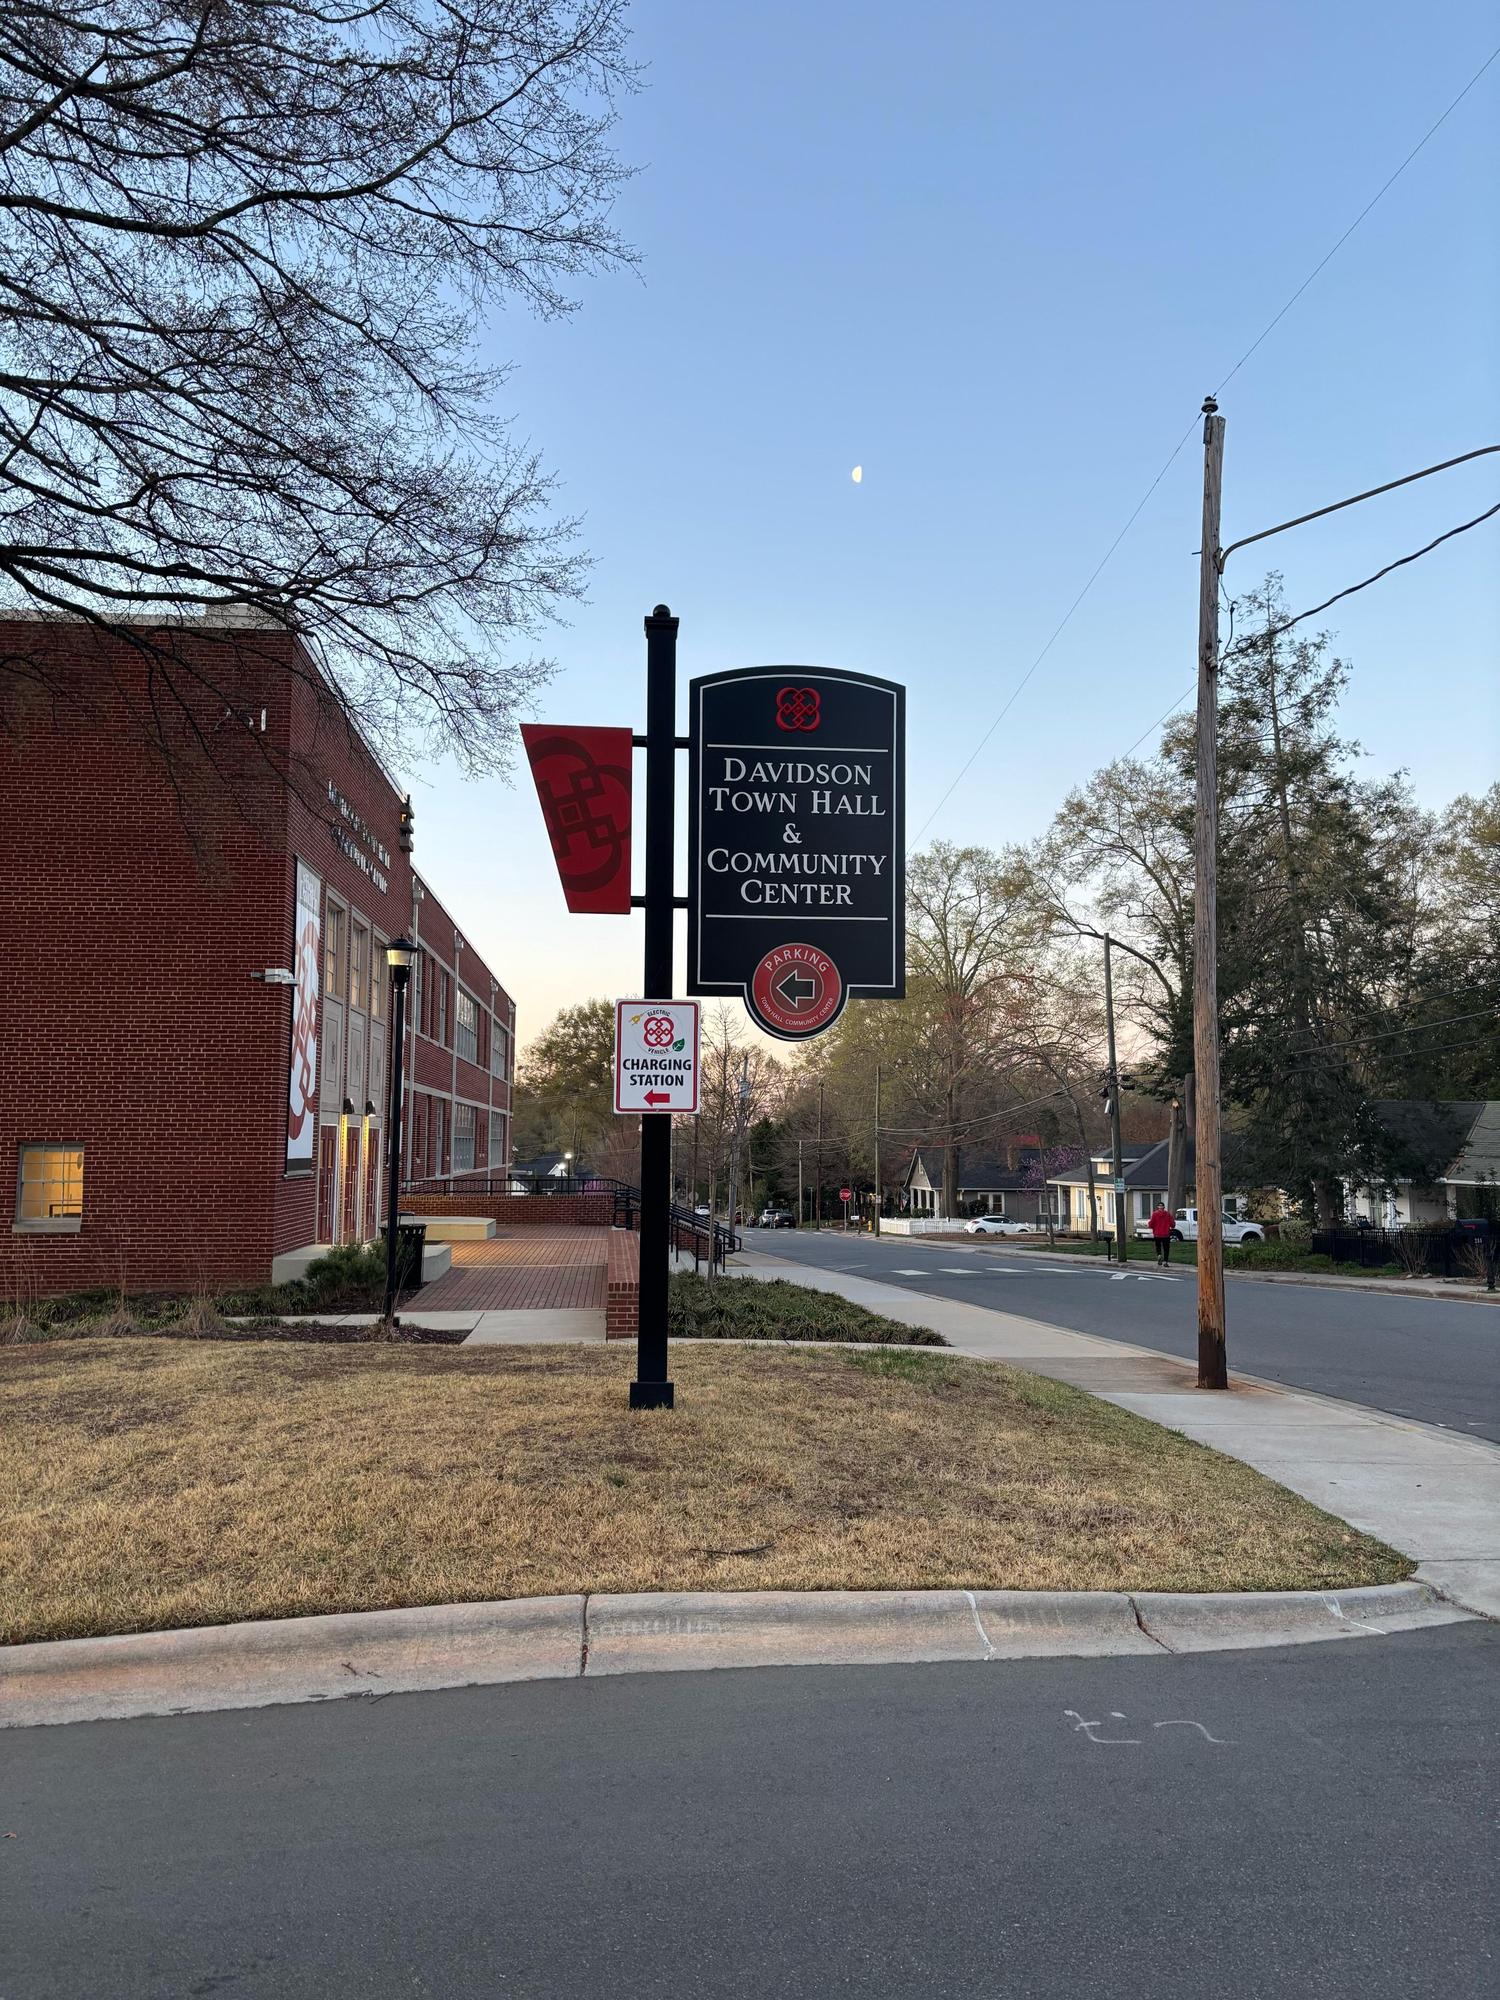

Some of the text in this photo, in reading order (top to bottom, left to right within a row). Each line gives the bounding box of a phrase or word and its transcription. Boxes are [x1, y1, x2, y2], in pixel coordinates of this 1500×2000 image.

[724, 757, 872, 785] DAVIDSON
[709, 787, 886, 815] TOWN HALL
[782, 823, 802, 844] &
[707, 848, 887, 875] COMMUNITY
[740, 879, 853, 905] CENTER
[765, 948, 829, 972] PARKING
[760, 996, 834, 1026] TOWN HALL COMMUNITY CENTER
[648, 1047, 669, 1055] VEHICLE
[623, 1059, 692, 1071] CHARGING
[629, 1074, 684, 1086] STATION
